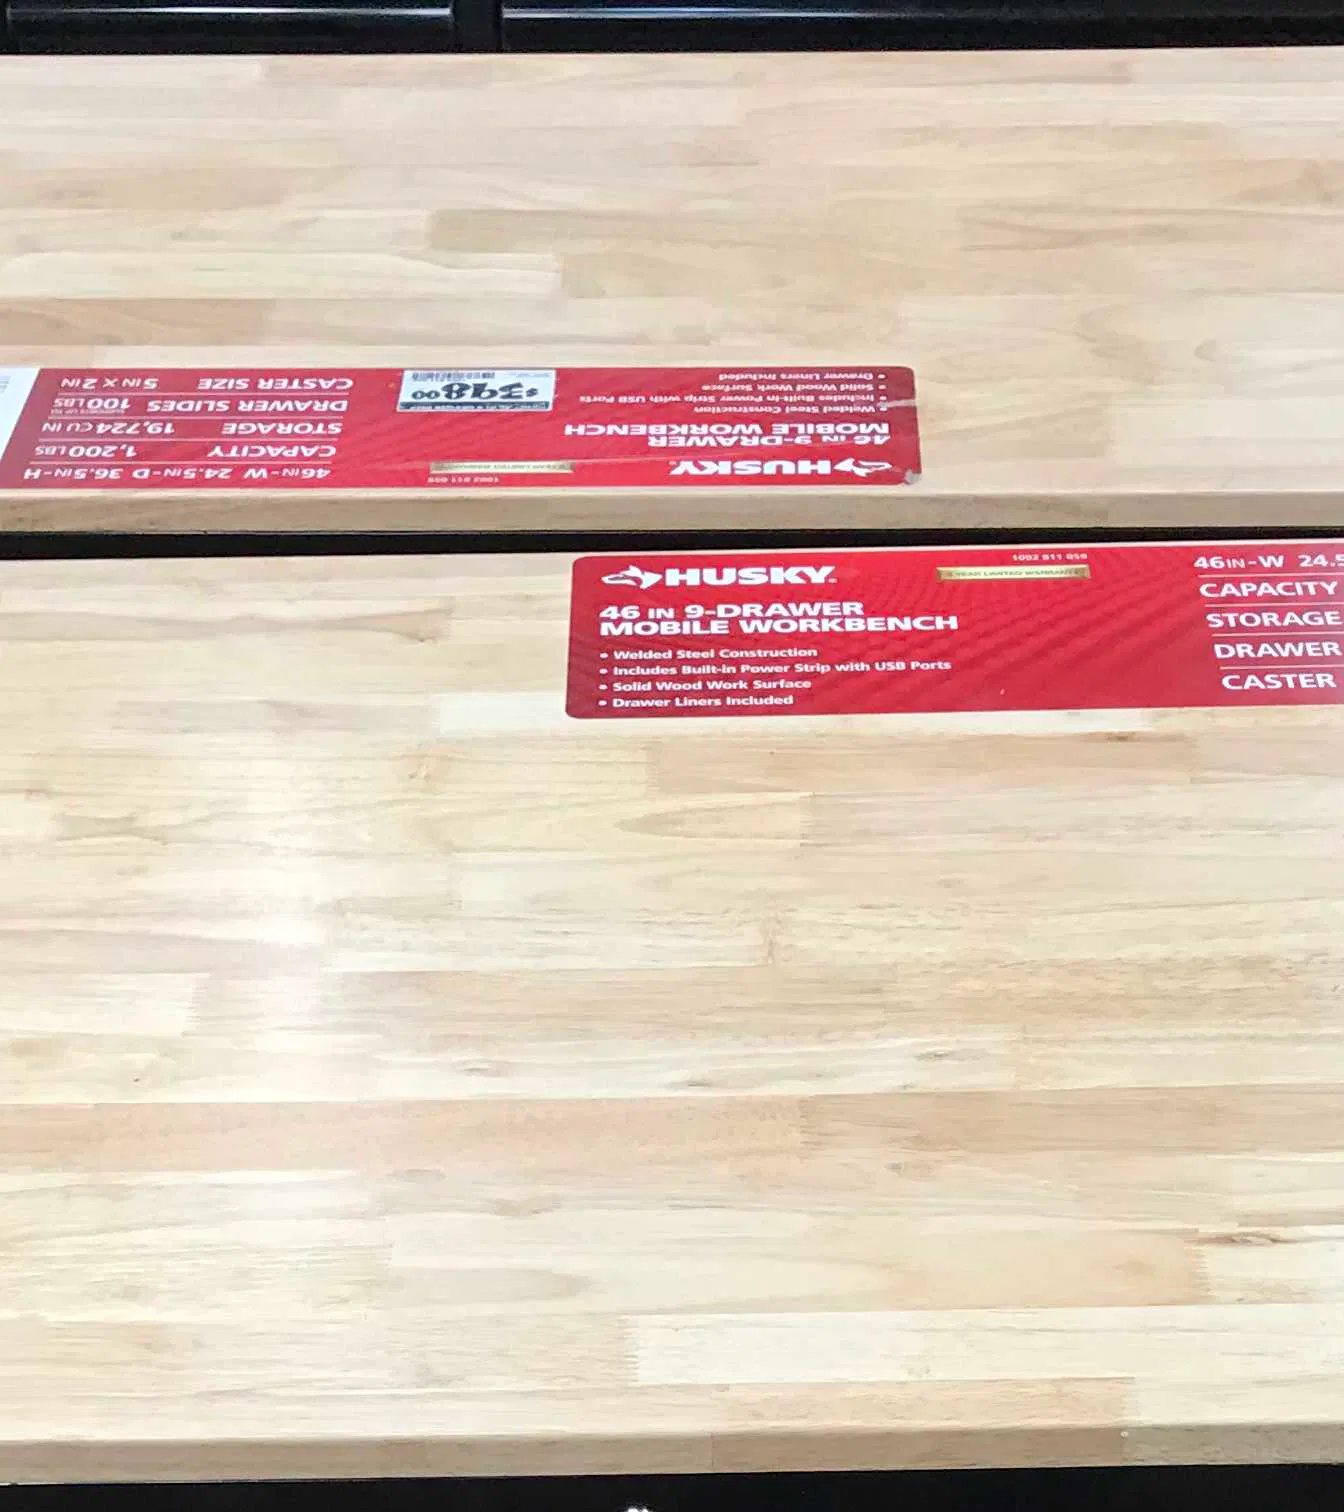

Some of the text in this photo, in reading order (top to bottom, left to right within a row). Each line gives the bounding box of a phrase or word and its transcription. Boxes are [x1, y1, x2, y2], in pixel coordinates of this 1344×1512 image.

[719, 373, 776, 381] Included
[198, 378, 250, 389] SIZE
[257, 378, 353, 389] CASTER
[580, 395, 615, 403] Ports
[618, 396, 645, 404] USB
[649, 395, 679, 403] with
[685, 394, 713, 403] Strip
[147, 400, 347, 412] DRAWER SLIDES
[694, 406, 781, 414] Construction
[823, 405, 875, 413] Welded
[41, 423, 62, 433] IN
[222, 422, 342, 434] STORAGE
[564, 423, 889, 436] MOBILE WORKBENCH
[648, 436, 811, 446] 9-DRAWER
[854, 435, 891, 444] 46
[207, 445, 336, 457] CAPACITY
[670, 460, 831, 475] HUSKY
[665, 565, 835, 586] HUSKY
[1200, 581, 1338, 598] CAPACITY
[598, 602, 864, 619] 46 IN 9-DRAWER
[600, 615, 958, 636] MOBILE WORKBENCH
[1206, 611, 1343, 629] STORAGE
[613, 647, 818, 659] Welded Steel Construction
[1214, 642, 1343, 660] DRAWER
[613, 660, 952, 676] Includes Built-in Power Strip with USB Ports
[613, 678, 812, 692] Solid Wood Work Surface
[1222, 672, 1336, 691] CASTER
[613, 694, 794, 708] Drawer Liners Included
